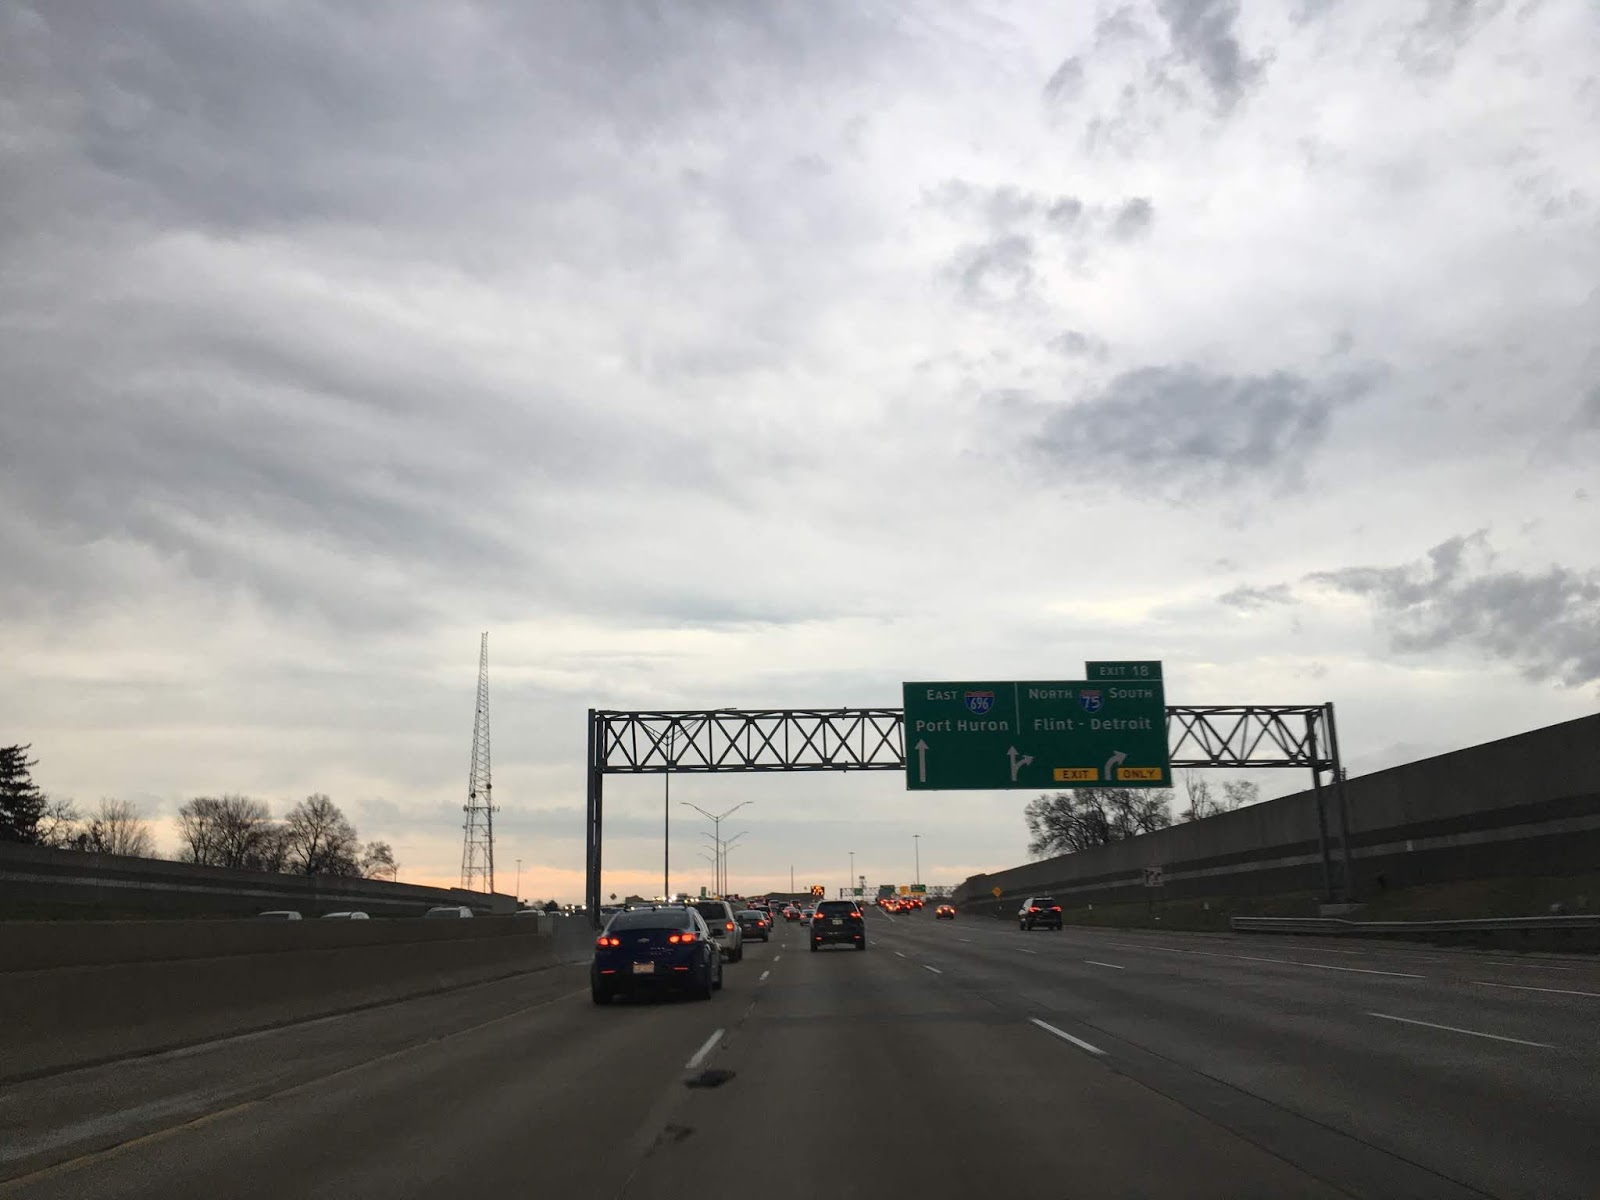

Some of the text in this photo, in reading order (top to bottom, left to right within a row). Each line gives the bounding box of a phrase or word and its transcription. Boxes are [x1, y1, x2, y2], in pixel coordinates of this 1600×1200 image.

[1100, 666, 1149, 676] EXIT 18
[927, 689, 957, 701] EAST
[1028, 688, 1073, 699] NORTH
[1109, 688, 1153, 699] SOUTH
[970, 697, 989, 710] 696
[1082, 696, 1100, 709] 75
[916, 719, 1009, 732] Port Huron
[1034, 718, 1074, 731] Flint
[1091, 718, 1152, 730] Detroit
[1063, 770, 1089, 779] EXIT
[1123, 770, 1155, 779] ONLY
